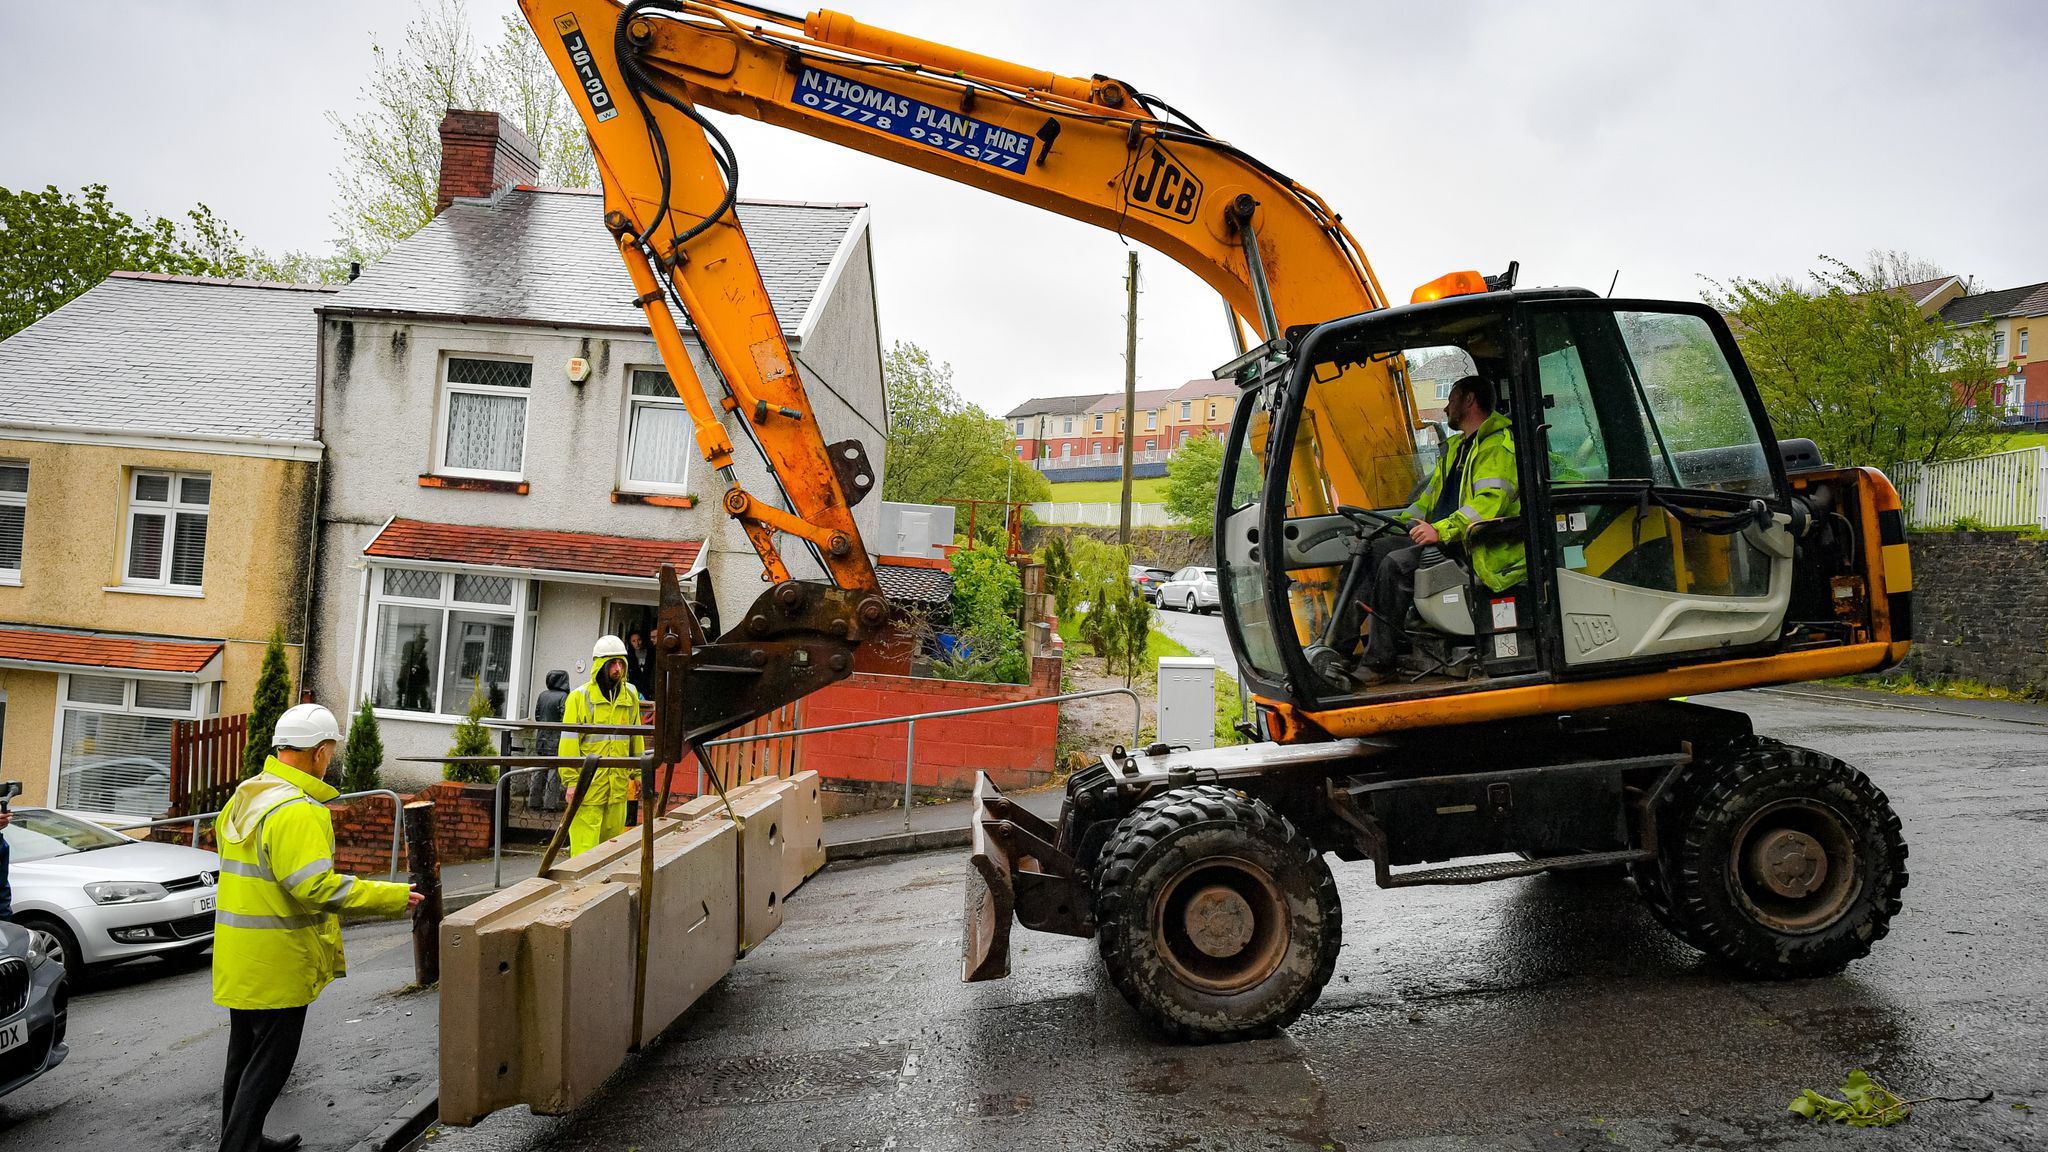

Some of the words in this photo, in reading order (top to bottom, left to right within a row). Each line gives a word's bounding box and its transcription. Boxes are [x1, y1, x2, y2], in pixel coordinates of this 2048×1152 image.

[570, 36, 609, 107] JS130
[801, 69, 910, 118] N.THOMAS
[915, 105, 979, 139] PLANT
[984, 127, 1029, 156] HIRE
[802, 93, 892, 130] 07778
[909, 126, 1019, 167] 937377
[1132, 148, 1197, 216] JCB
[1571, 615, 1619, 654] JCB
